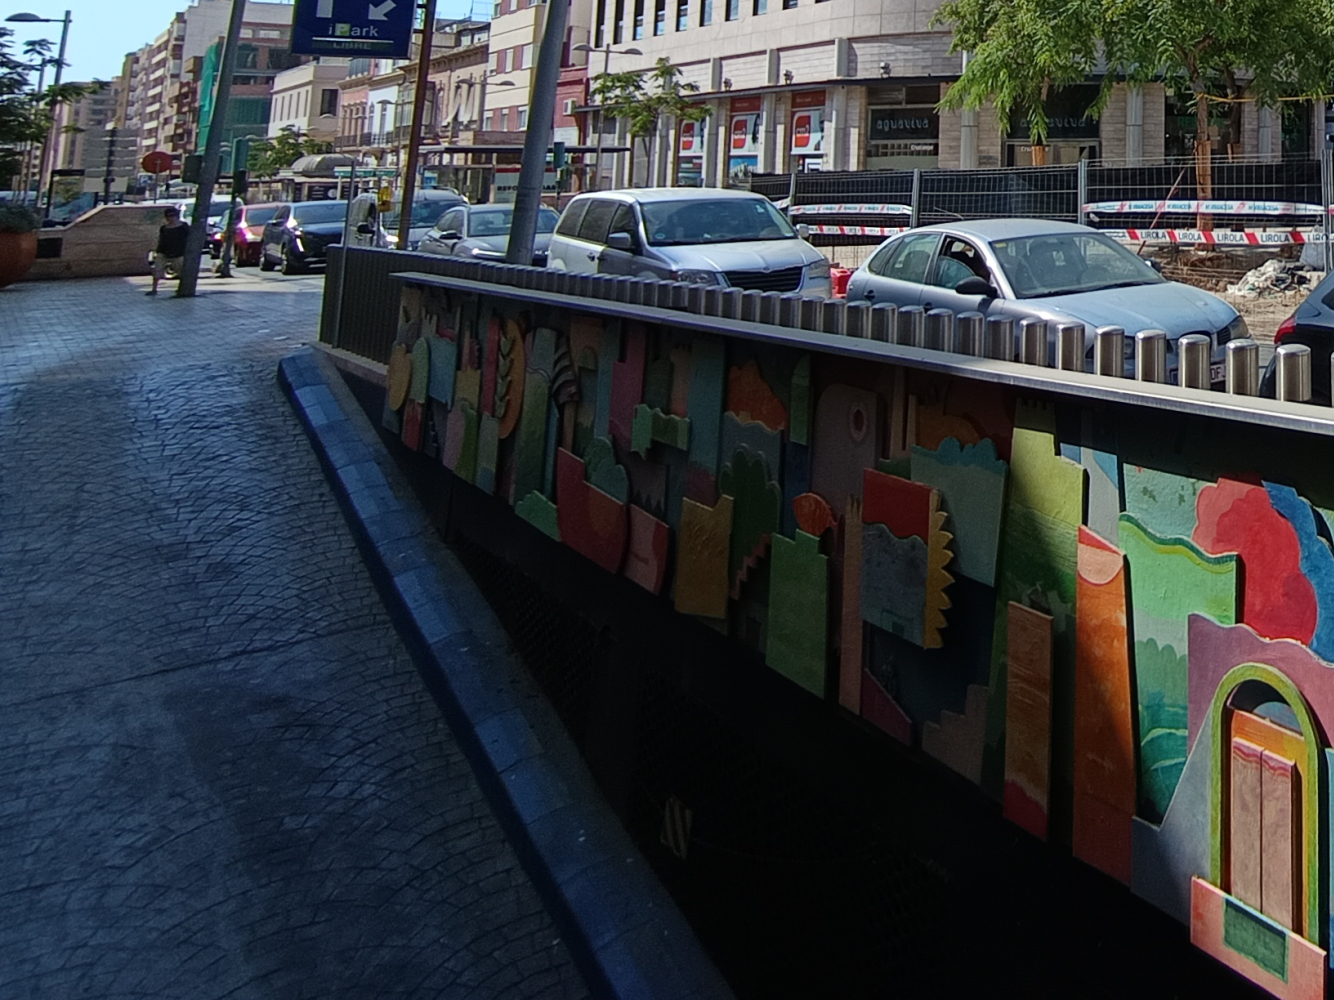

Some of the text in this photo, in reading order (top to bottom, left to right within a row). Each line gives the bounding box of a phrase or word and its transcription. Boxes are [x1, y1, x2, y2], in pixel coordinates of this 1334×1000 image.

[328, 23, 379, 37] iPark
[1140, 230, 1167, 240] LIROLA
[1177, 231, 1203, 242] LIROLA
[1216, 232, 1245, 243] LIROLA
[1260, 232, 1290, 243] LIROLA
